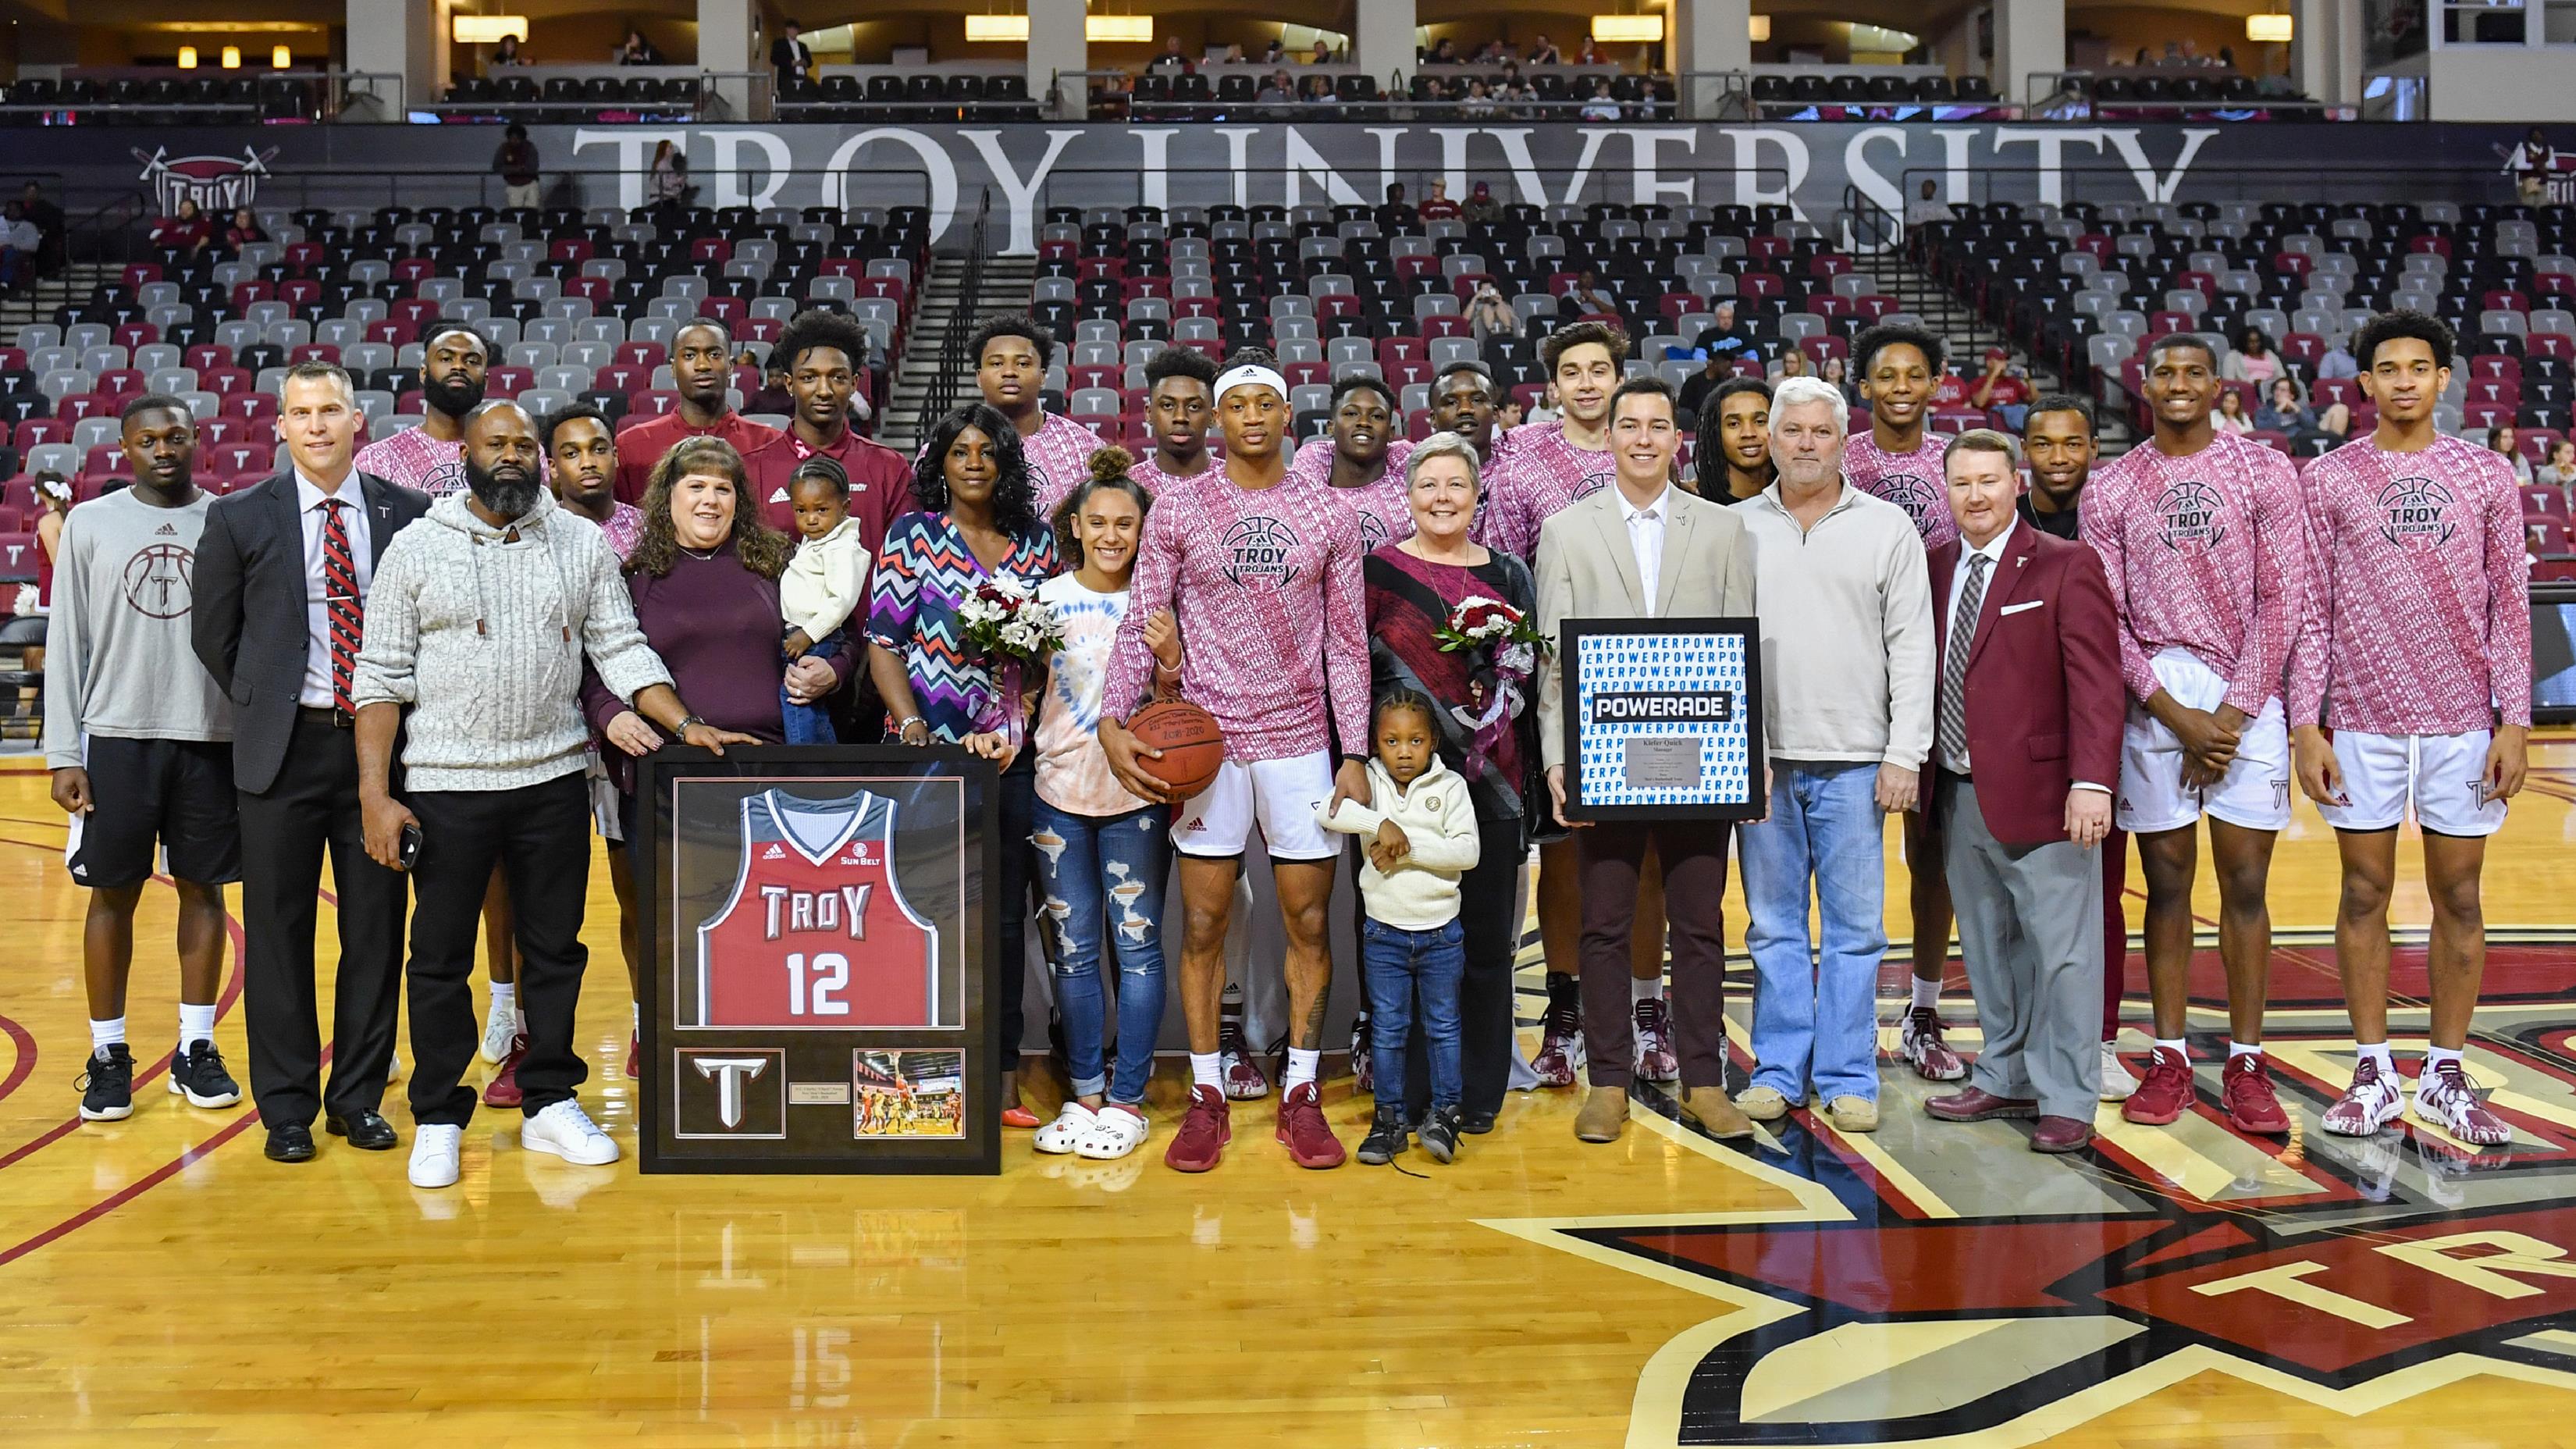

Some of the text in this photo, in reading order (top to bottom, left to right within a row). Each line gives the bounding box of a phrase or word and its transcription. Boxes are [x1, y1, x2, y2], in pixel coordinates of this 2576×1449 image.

[573, 125, 2220, 255] TROY UNIVERSITY
[585, 230, 596, 241] T
[720, 230, 730, 240] T
[429, 247, 440, 260] T
[843, 246, 854, 258] T
[1053, 247, 1063, 258] T
[1140, 244, 1151, 257] T
[1965, 241, 1976, 253] T
[2048, 242, 2058, 253] T
[165, 251, 176, 263] T
[341, 249, 352, 262] T
[789, 266, 799, 277] T
[1229, 264, 1241, 276] T
[1505, 261, 1515, 272] T
[1597, 261, 1609, 273] T
[1736, 261, 1748, 273] T
[2289, 258, 2300, 271] T
[484, 285, 495, 297] T
[632, 283, 642, 297] T
[730, 283, 741, 296] T
[875, 283, 887, 296] T
[1374, 281, 1386, 294] T
[1802, 281, 1813, 294] T
[2015, 279, 2026, 291] T
[2148, 278, 2159, 290] T
[2369, 278, 2380, 290] T
[2460, 278, 2471, 290] T
[2549, 279, 2560, 290] T
[106, 290, 118, 303] T
[199, 289, 211, 302] T
[294, 287, 305, 301] T
[1094, 285, 1107, 298] T
[1627, 301, 1638, 313] T
[1676, 301, 1688, 313] T
[1871, 301, 1883, 315] T
[2225, 297, 2237, 311] T
[409, 306, 422, 320] T
[1048, 308, 1060, 321] T
[333, 326, 345, 340] T
[542, 326, 554, 340] T
[596, 325, 607, 340] T
[753, 326, 767, 340] T
[1190, 326, 1201, 339] T
[1240, 323, 1253, 337] T
[1542, 321, 1555, 335] T
[2073, 319, 2085, 333] T
[130, 331, 142, 346] T
[1140, 348, 1152, 361] T
[1293, 346, 1305, 360] T
[1344, 346, 1357, 360] T
[1395, 345, 1408, 360] T
[1447, 344, 1461, 358] T
[1764, 343, 1777, 358] T
[1816, 344, 1830, 358] T
[2298, 340, 2311, 355] T
[202, 352, 215, 367] T
[255, 351, 268, 366] T
[1090, 348, 1101, 362] T
[558, 373, 571, 387] T
[614, 372, 628, 388] T
[1514, 367, 1528, 382] T
[59, 377, 73, 393] T
[112, 376, 126, 392] T
[389, 375, 403, 390] T
[502, 374, 516, 390] T
[2329, 386, 2343, 401] T
[2485, 385, 2499, 401] T
[2539, 386, 2552, 401] T
[1087, 397, 1101, 412] T
[1307, 393, 1321, 408] T
[17, 403, 32, 420] T
[244, 401, 258, 416] T
[91, 426, 105, 443] T
[2533, 437, 2548, 454] T
[234, 450, 249, 468] T
[2532, 493, 2548, 512] T
[1904, 504, 1927, 518] OY
[2389, 507, 2443, 524] TROY
[2166, 511, 2213, 529] TROY
[2172, 527, 2211, 538] TROJANS
[2396, 524, 2440, 532] TROJANS
[1233, 548, 1287, 563] TROY
[151, 576, 179, 607] T
[2270, 780, 2288, 810] T
[860, 857, 880, 866] BELT
[760, 883, 873, 941] TROY
[788, 953, 849, 1015] 12
[693, 1057, 767, 1129] T
